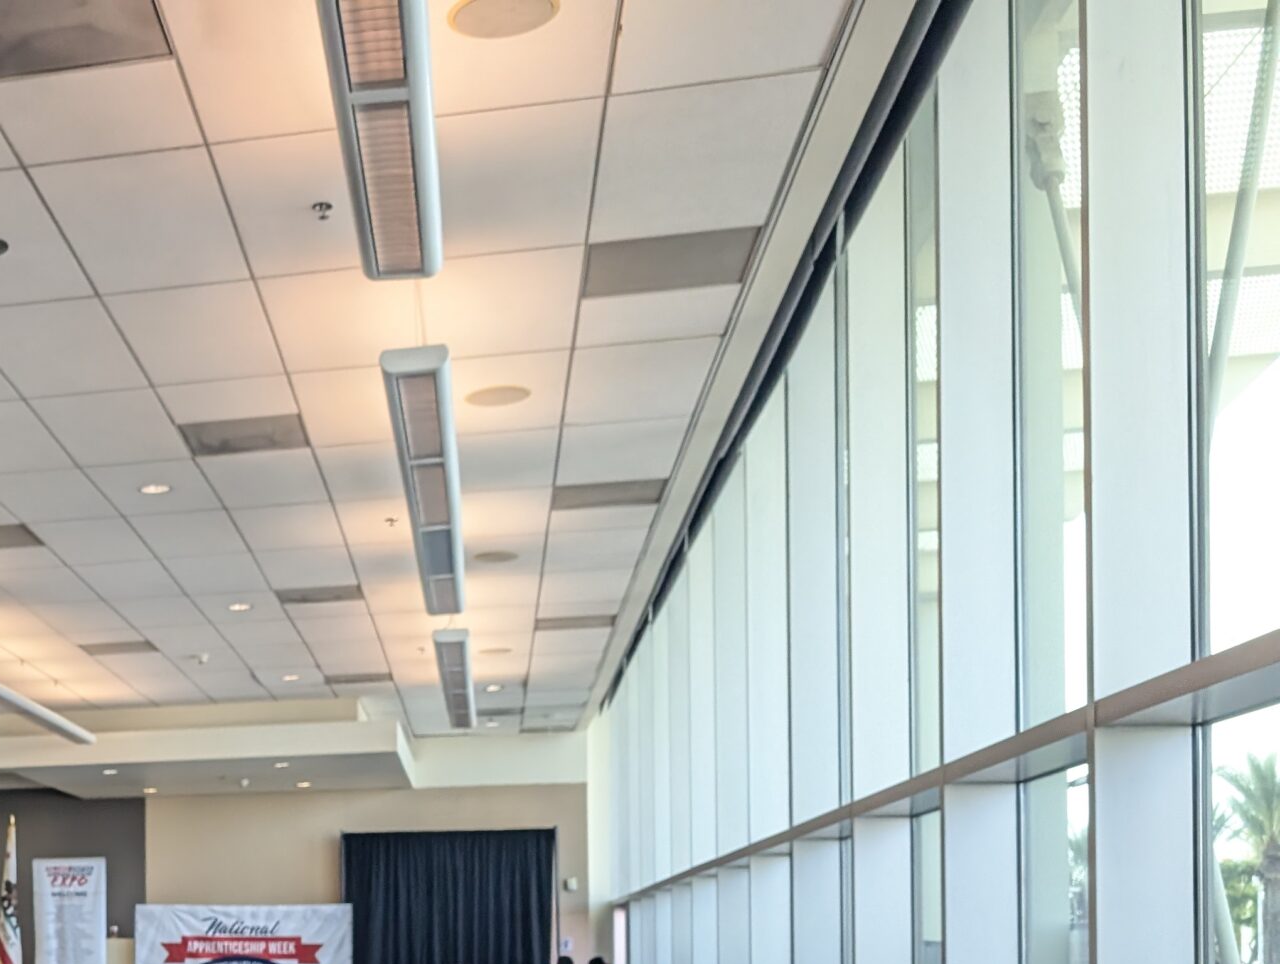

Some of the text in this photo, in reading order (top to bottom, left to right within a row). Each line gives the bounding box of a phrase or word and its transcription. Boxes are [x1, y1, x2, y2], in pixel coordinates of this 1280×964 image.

[51, 875, 88, 888] EXPO
[201, 916, 280, 936] National
[187, 940, 296, 955] APPRENTICESHIP WEEK
